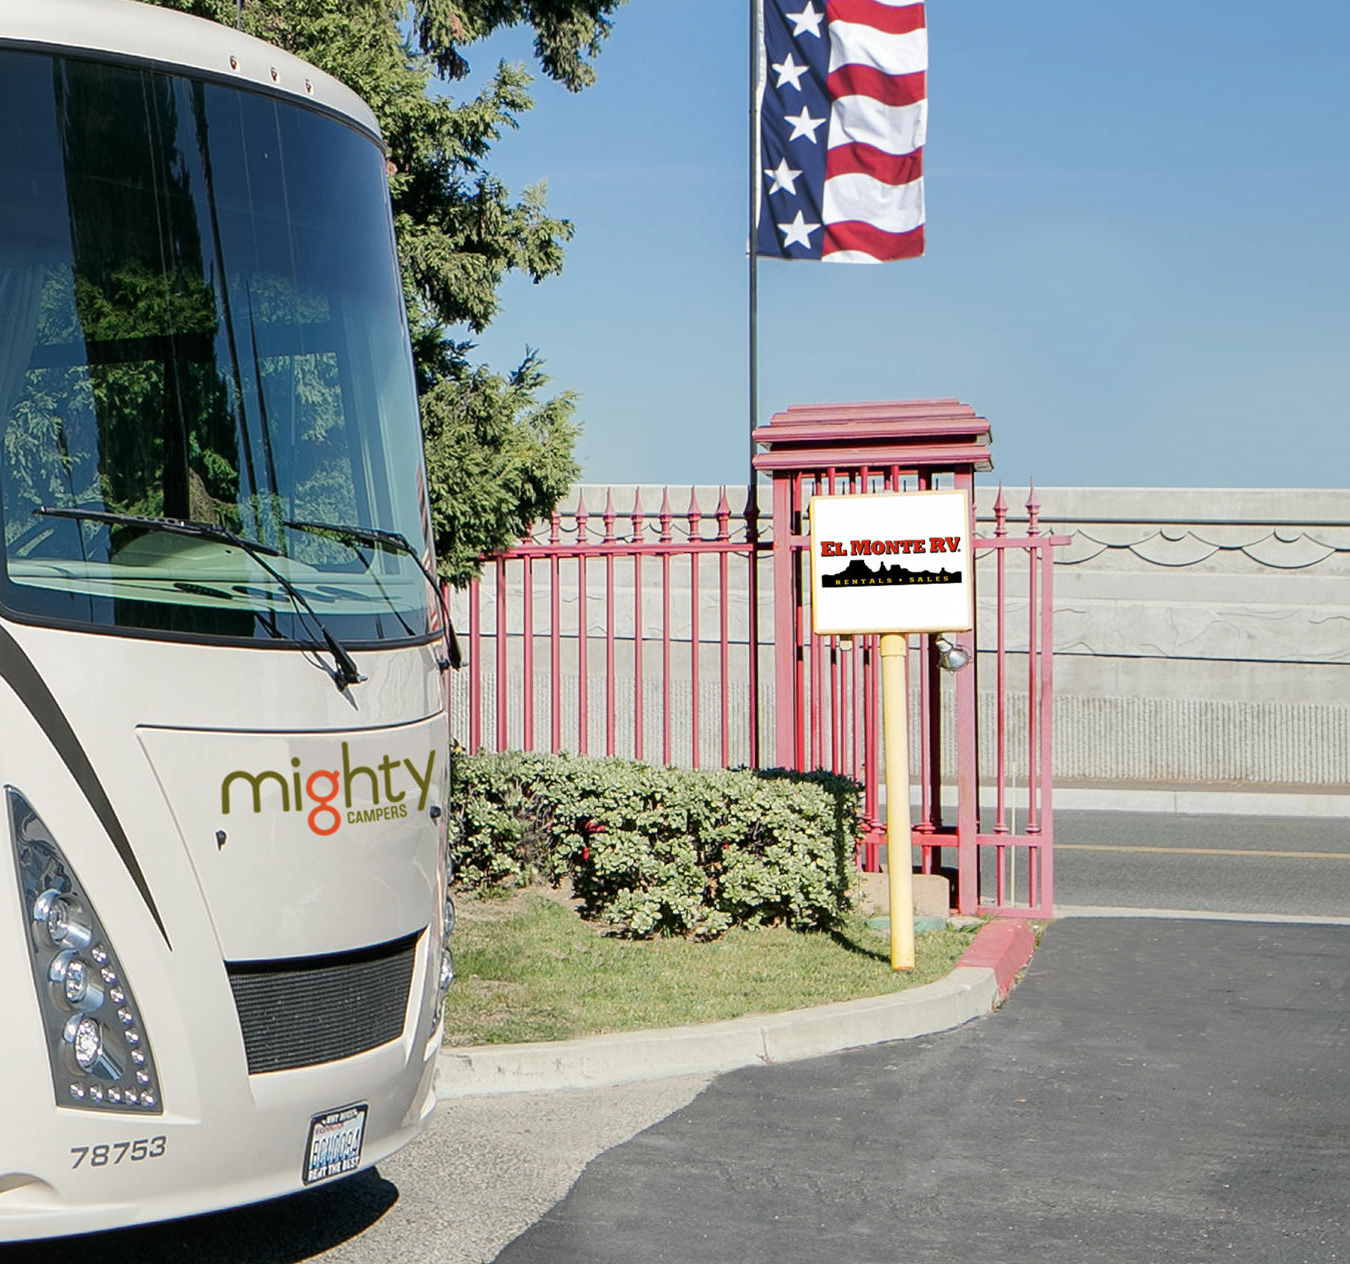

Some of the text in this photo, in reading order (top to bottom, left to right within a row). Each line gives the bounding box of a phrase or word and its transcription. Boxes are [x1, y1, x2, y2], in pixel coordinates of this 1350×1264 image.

[820, 540, 848, 557] EL
[850, 539, 926, 556] MONTE
[835, 575, 950, 586] RENTALS SALES
[221, 741, 436, 836] mighty
[347, 804, 408, 824] CAMPERS
[70, 1135, 167, 1169] 78753
[328, 1161, 342, 1176] THE
